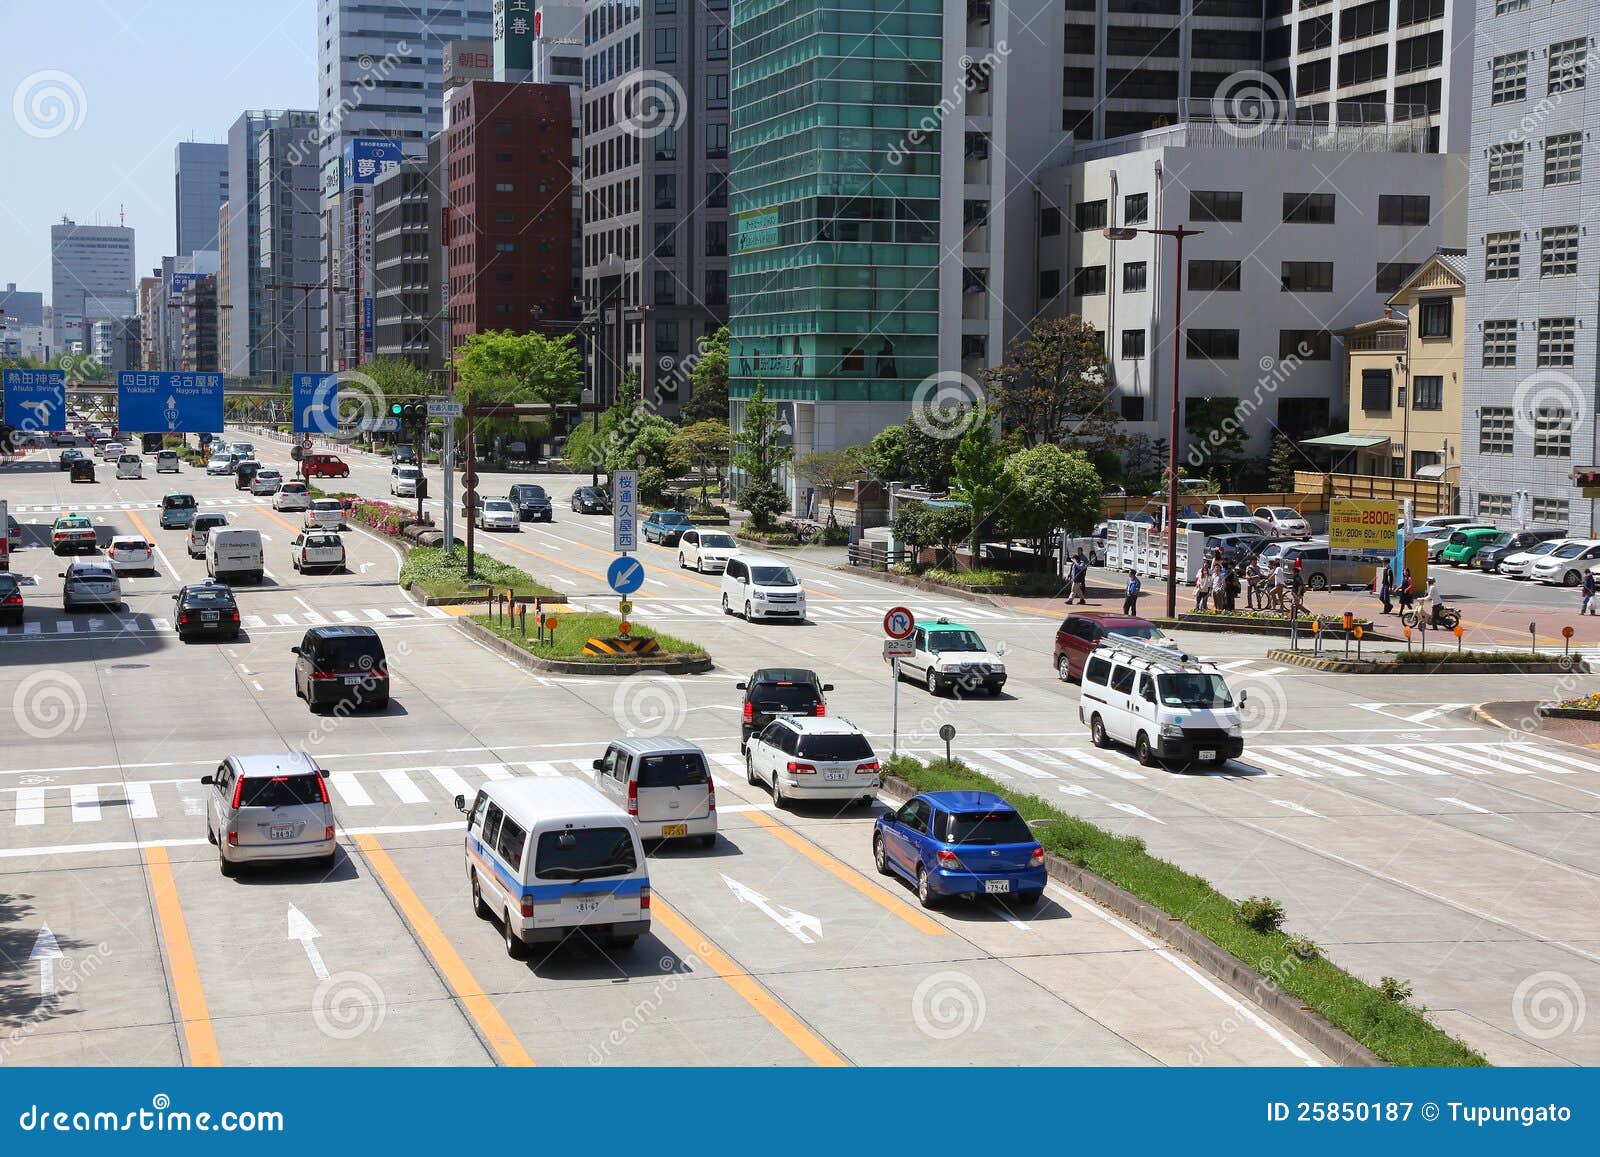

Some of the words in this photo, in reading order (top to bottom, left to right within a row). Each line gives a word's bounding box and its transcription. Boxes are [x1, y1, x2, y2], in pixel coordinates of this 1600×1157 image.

[458, 53, 493, 68] 朝日
[122, 374, 160, 386] 四日市
[170, 375, 219, 387] 名古屋駅
[166, 411, 176, 419] 19
[618, 475, 633, 547] 桜通久屋西
[1362, 511, 1395, 525] 2800円
